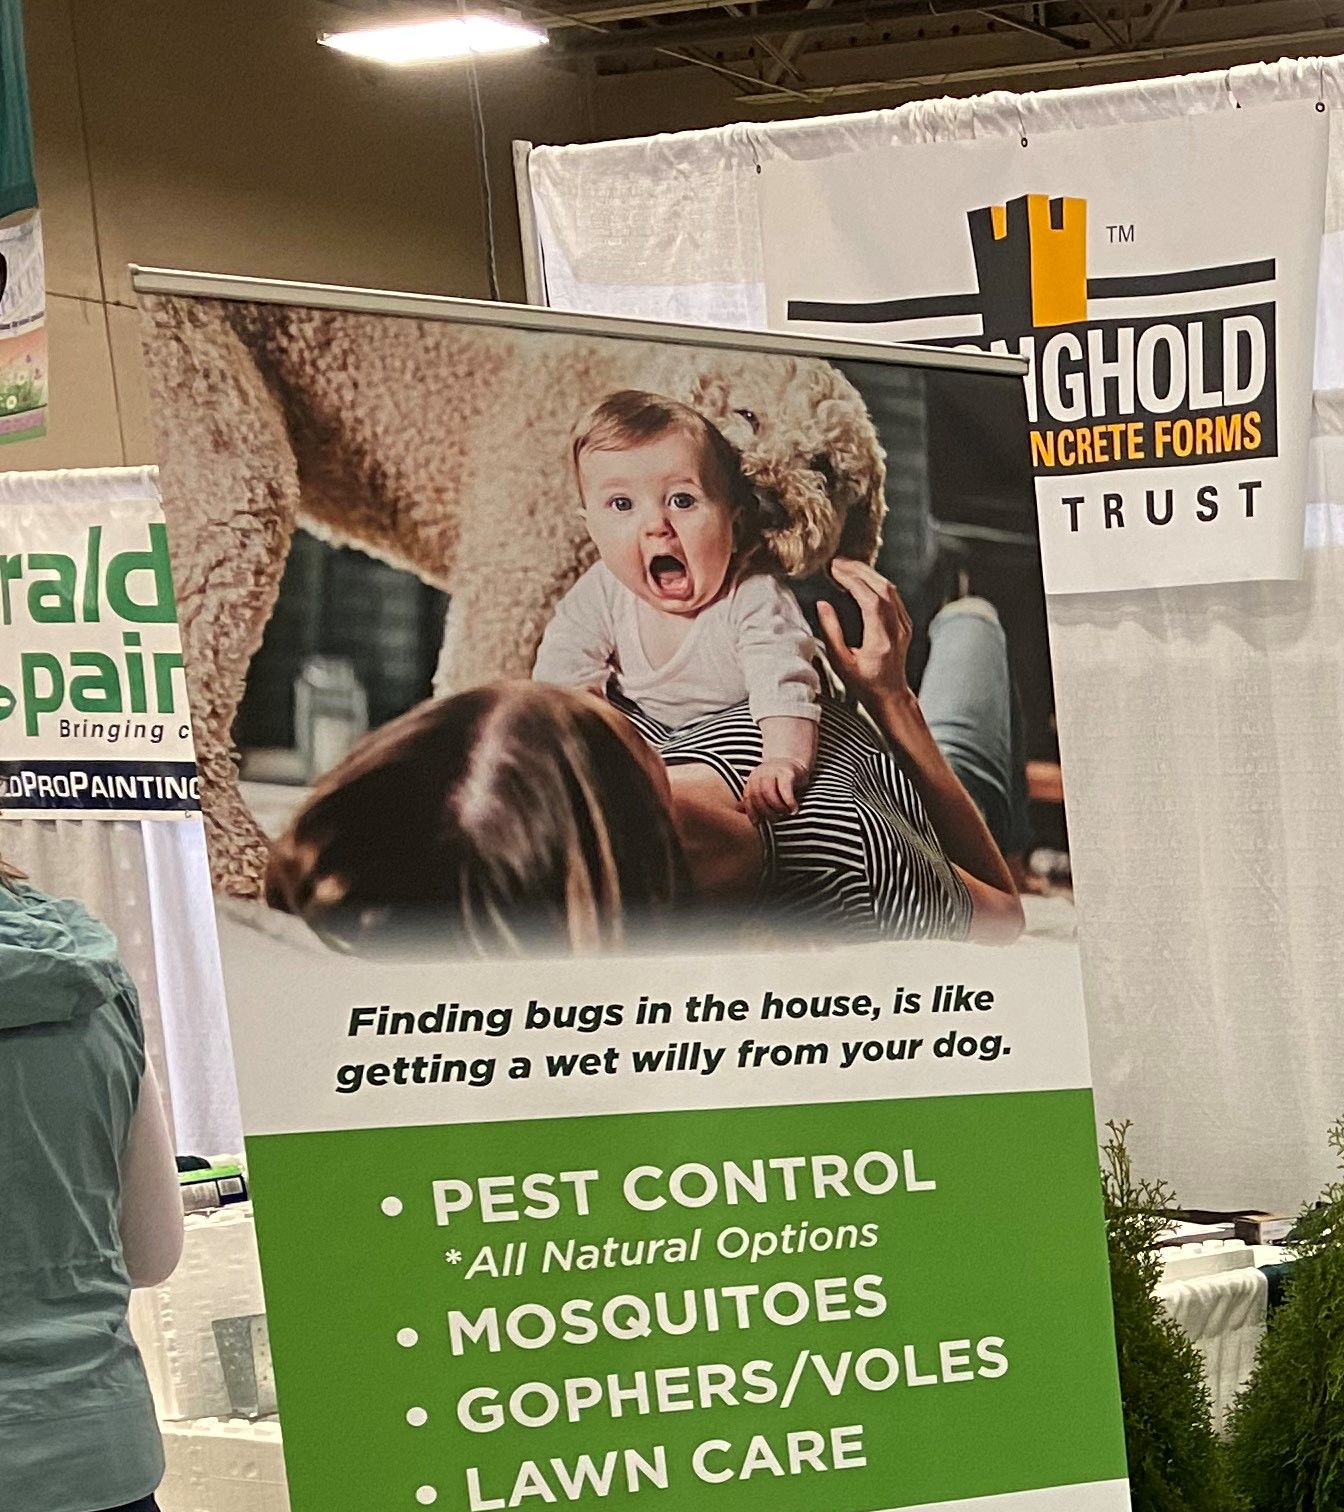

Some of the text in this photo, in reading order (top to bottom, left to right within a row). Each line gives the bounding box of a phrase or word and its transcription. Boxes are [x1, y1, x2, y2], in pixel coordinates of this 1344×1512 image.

[1106, 225, 1135, 243] TM
[1155, 411, 1261, 458] FORMS
[1062, 481, 1262, 533] TRUST
[60, 719, 164, 743] Bringing
[347, 984, 995, 1037] Finding bugs in the house, is like
[335, 1030, 1013, 1093] getting a wet willy from your dog.
[432, 1148, 936, 1226] PEST CONTROL
[542, 1228, 702, 1274] Natural
[716, 1221, 879, 1263] Options
[447, 1274, 889, 1356] MOSQUITOES
[456, 1336, 1010, 1433] GOPHERS/VOLES
[466, 1424, 867, 1512] LAWN CARE
